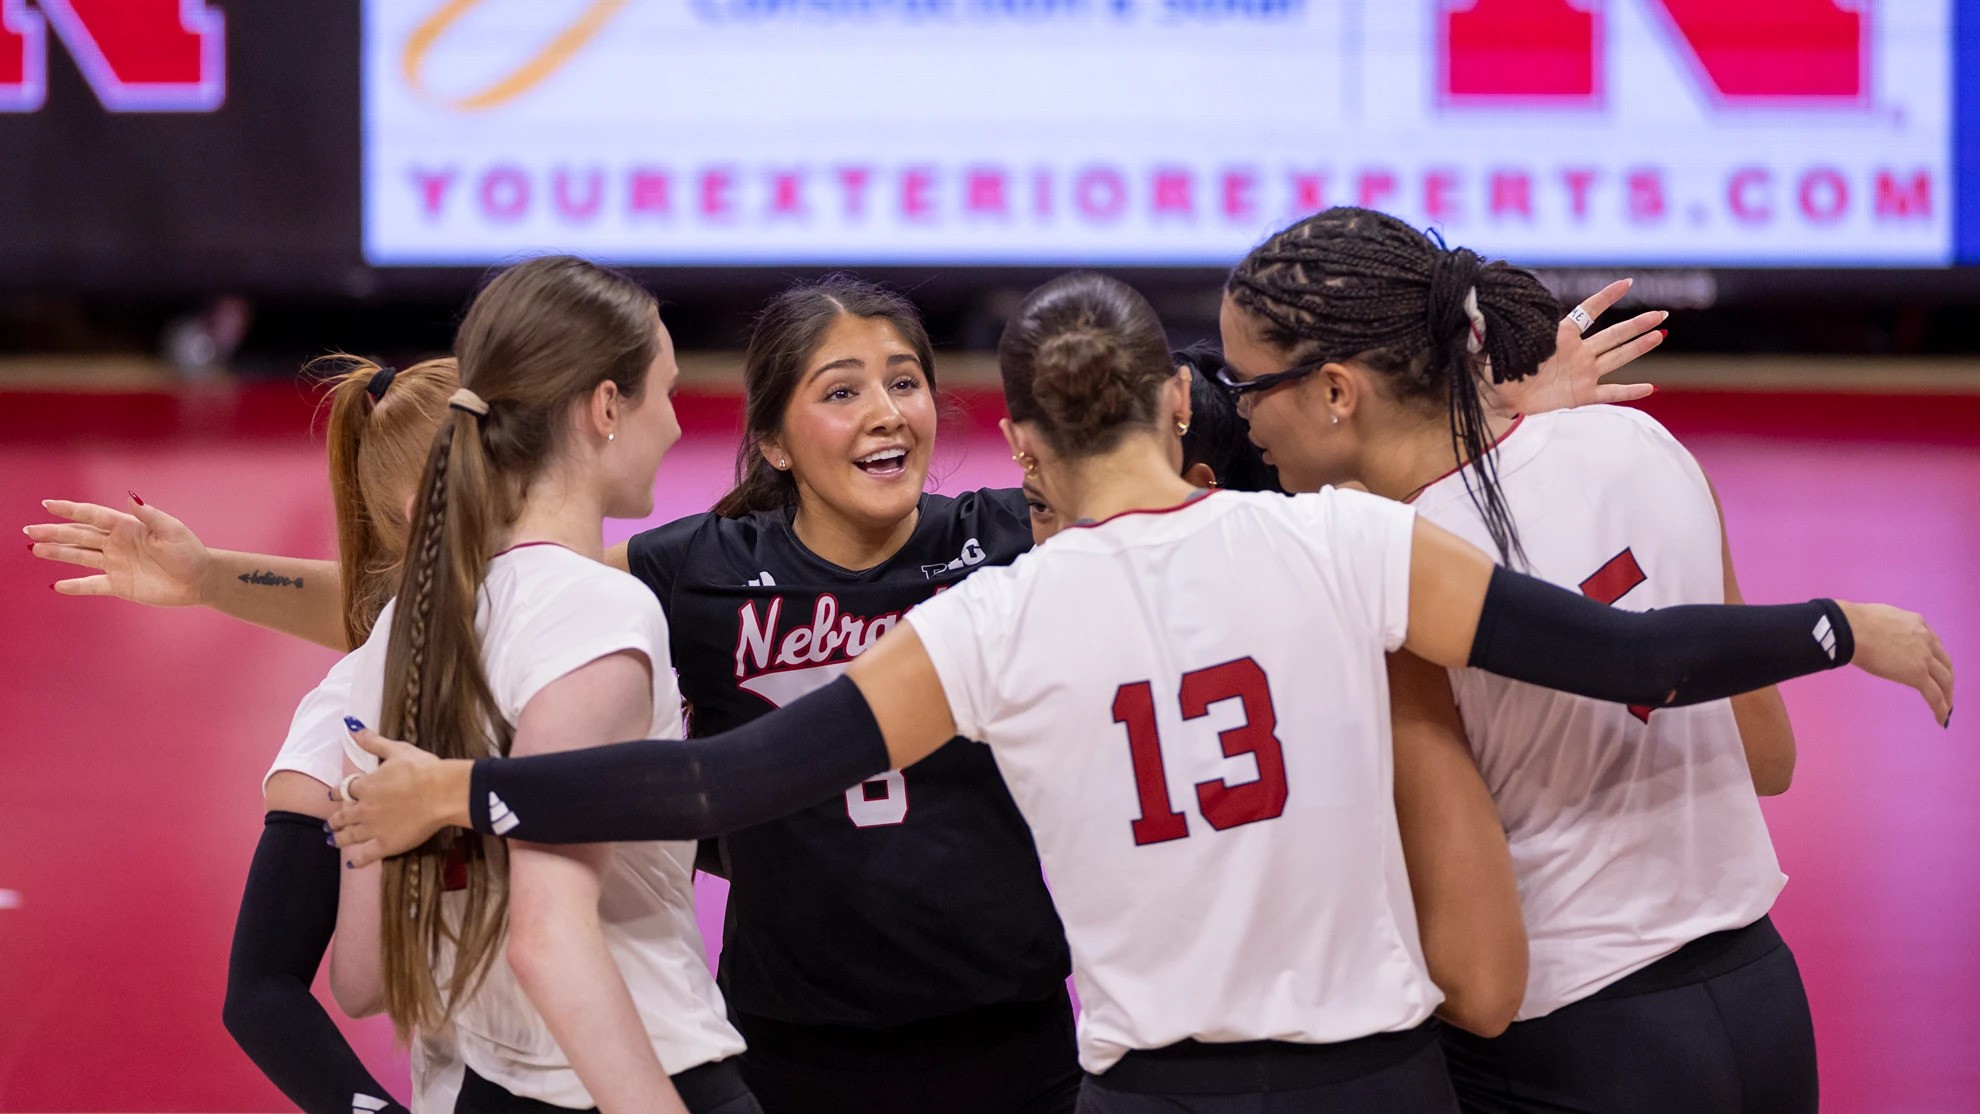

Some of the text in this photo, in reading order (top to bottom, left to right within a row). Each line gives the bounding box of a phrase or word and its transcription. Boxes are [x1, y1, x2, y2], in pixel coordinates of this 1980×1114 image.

[411, 166, 1934, 222] YOUREXTERIOREXPERTS.COM
[735, 585, 946, 677] Nebra
[1111, 655, 1288, 846] 13
